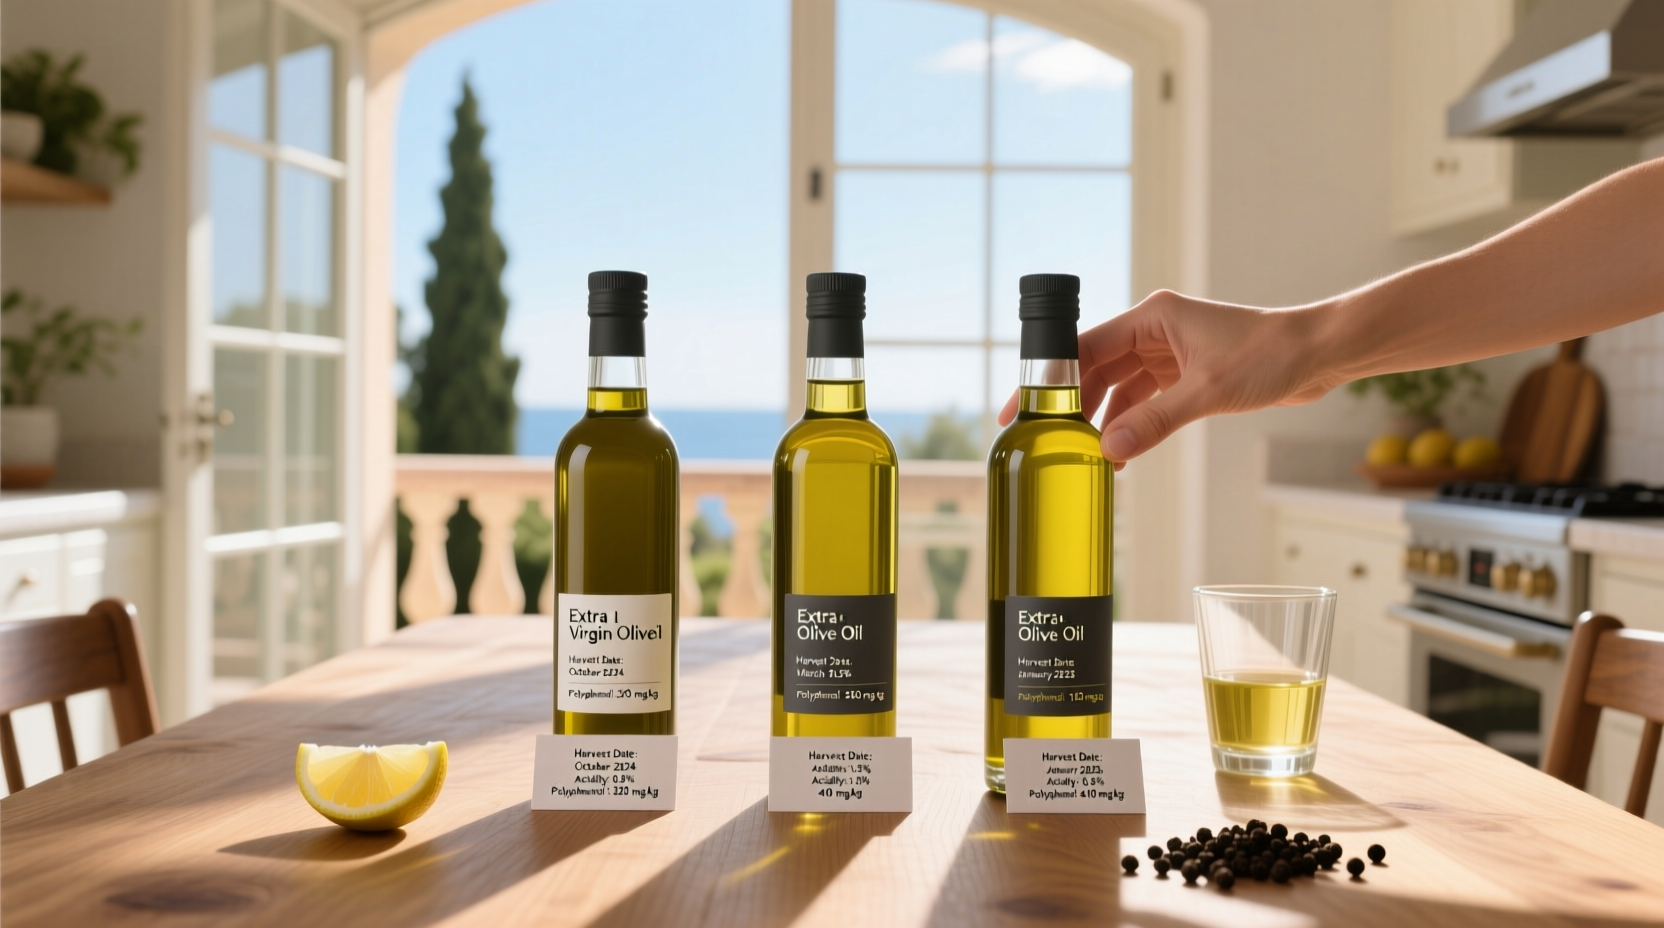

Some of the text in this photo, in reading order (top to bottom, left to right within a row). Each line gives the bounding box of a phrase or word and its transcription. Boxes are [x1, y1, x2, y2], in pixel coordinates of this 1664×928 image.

[569, 608, 608, 623] Extra
[798, 609, 837, 624] Extra
[1019, 610, 1058, 624] Extra
[569, 624, 612, 644] Virgin
[797, 624, 862, 640] Olive Oil
[1018, 625, 1084, 641] Olive Oil
[818, 788, 832, 797] 40
